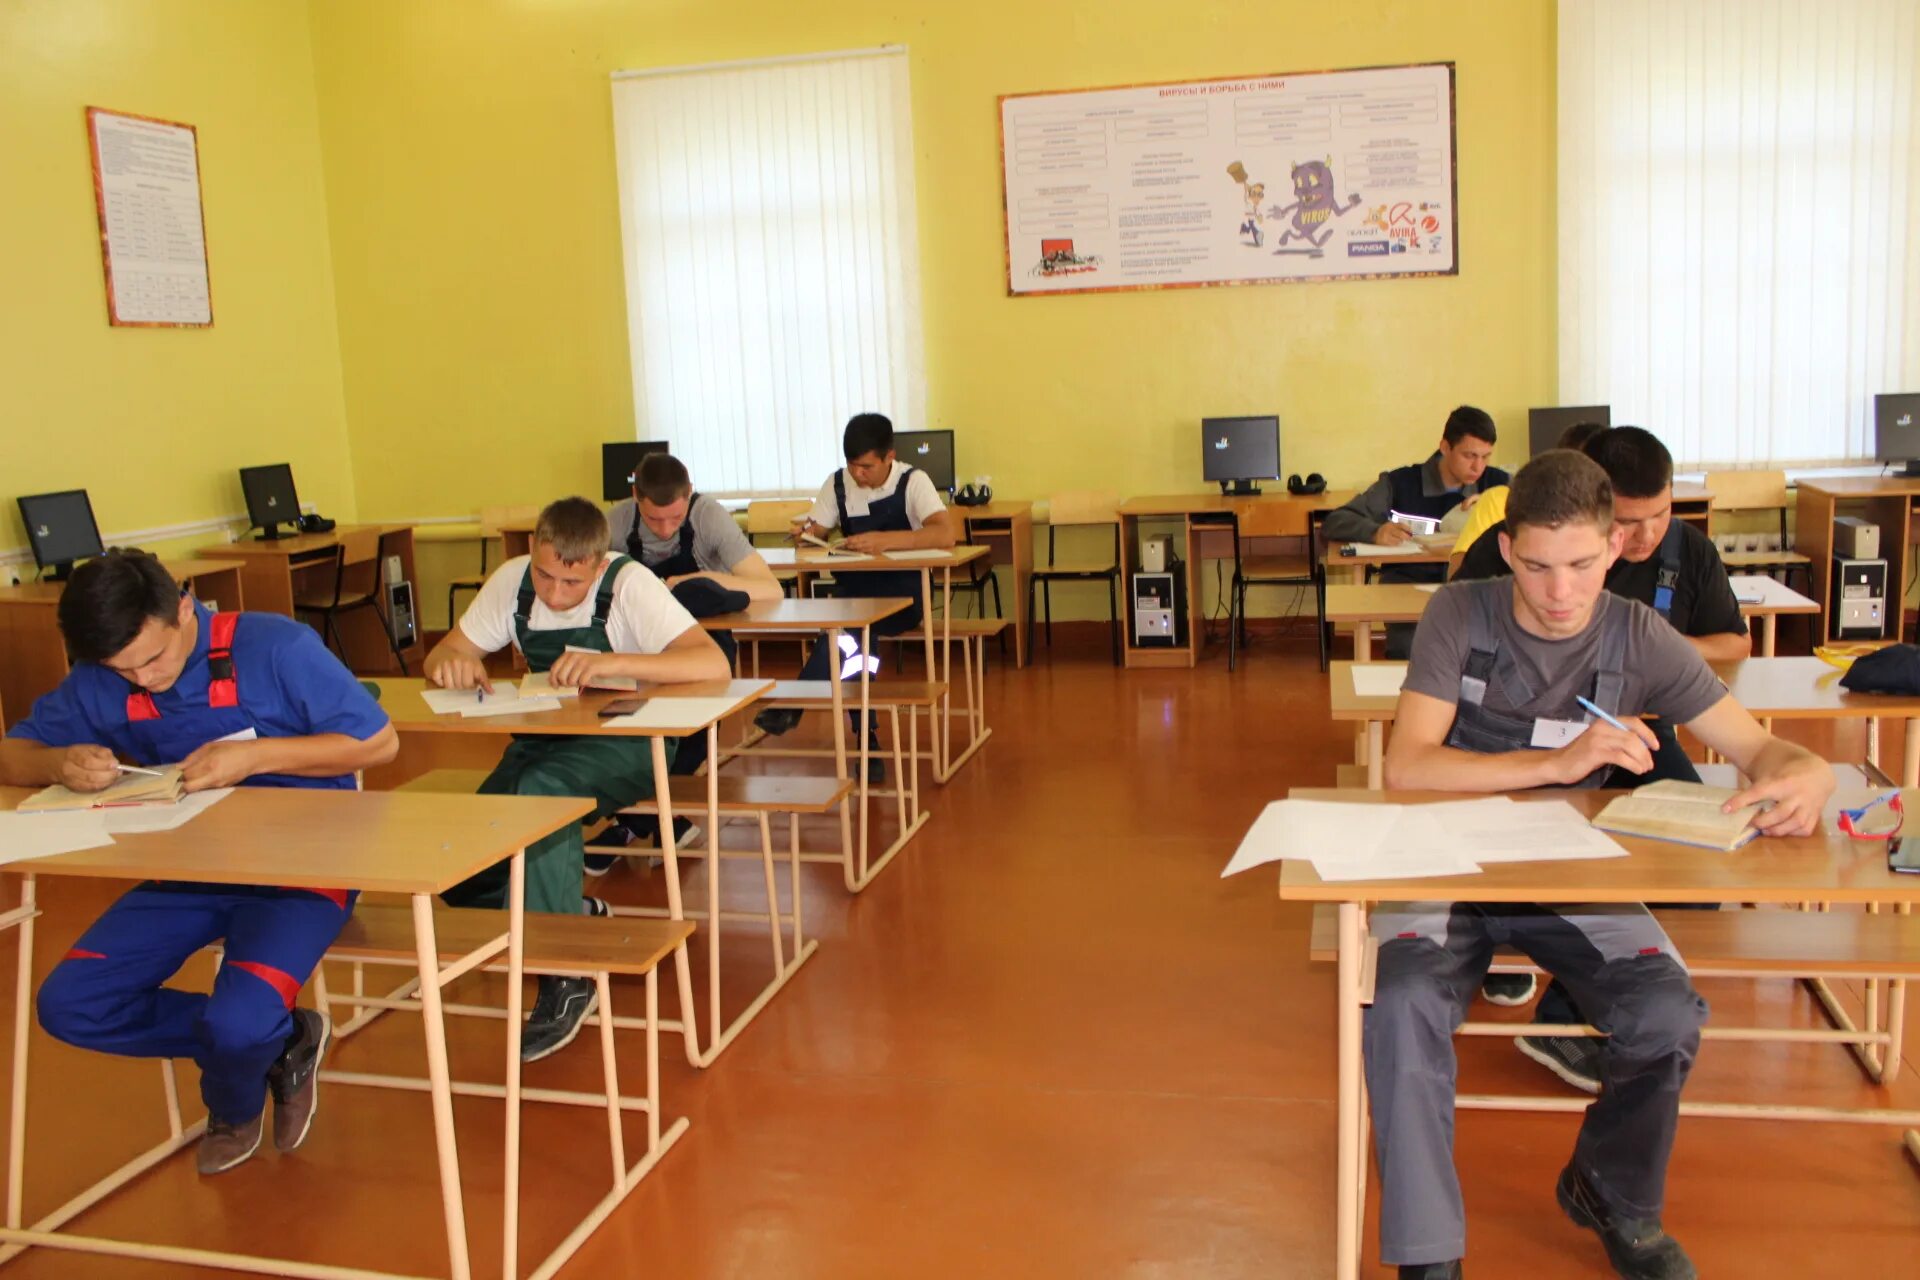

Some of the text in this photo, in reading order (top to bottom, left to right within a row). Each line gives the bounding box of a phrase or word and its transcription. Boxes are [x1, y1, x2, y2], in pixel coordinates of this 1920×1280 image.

[1159, 81, 1285, 97] ВИРУСЫ И БОРЬБА С НИМИ
[1301, 208, 1330, 225] VIRUS
[1389, 227, 1416, 239] AVIRA
[1351, 243, 1385, 254] PANDA
